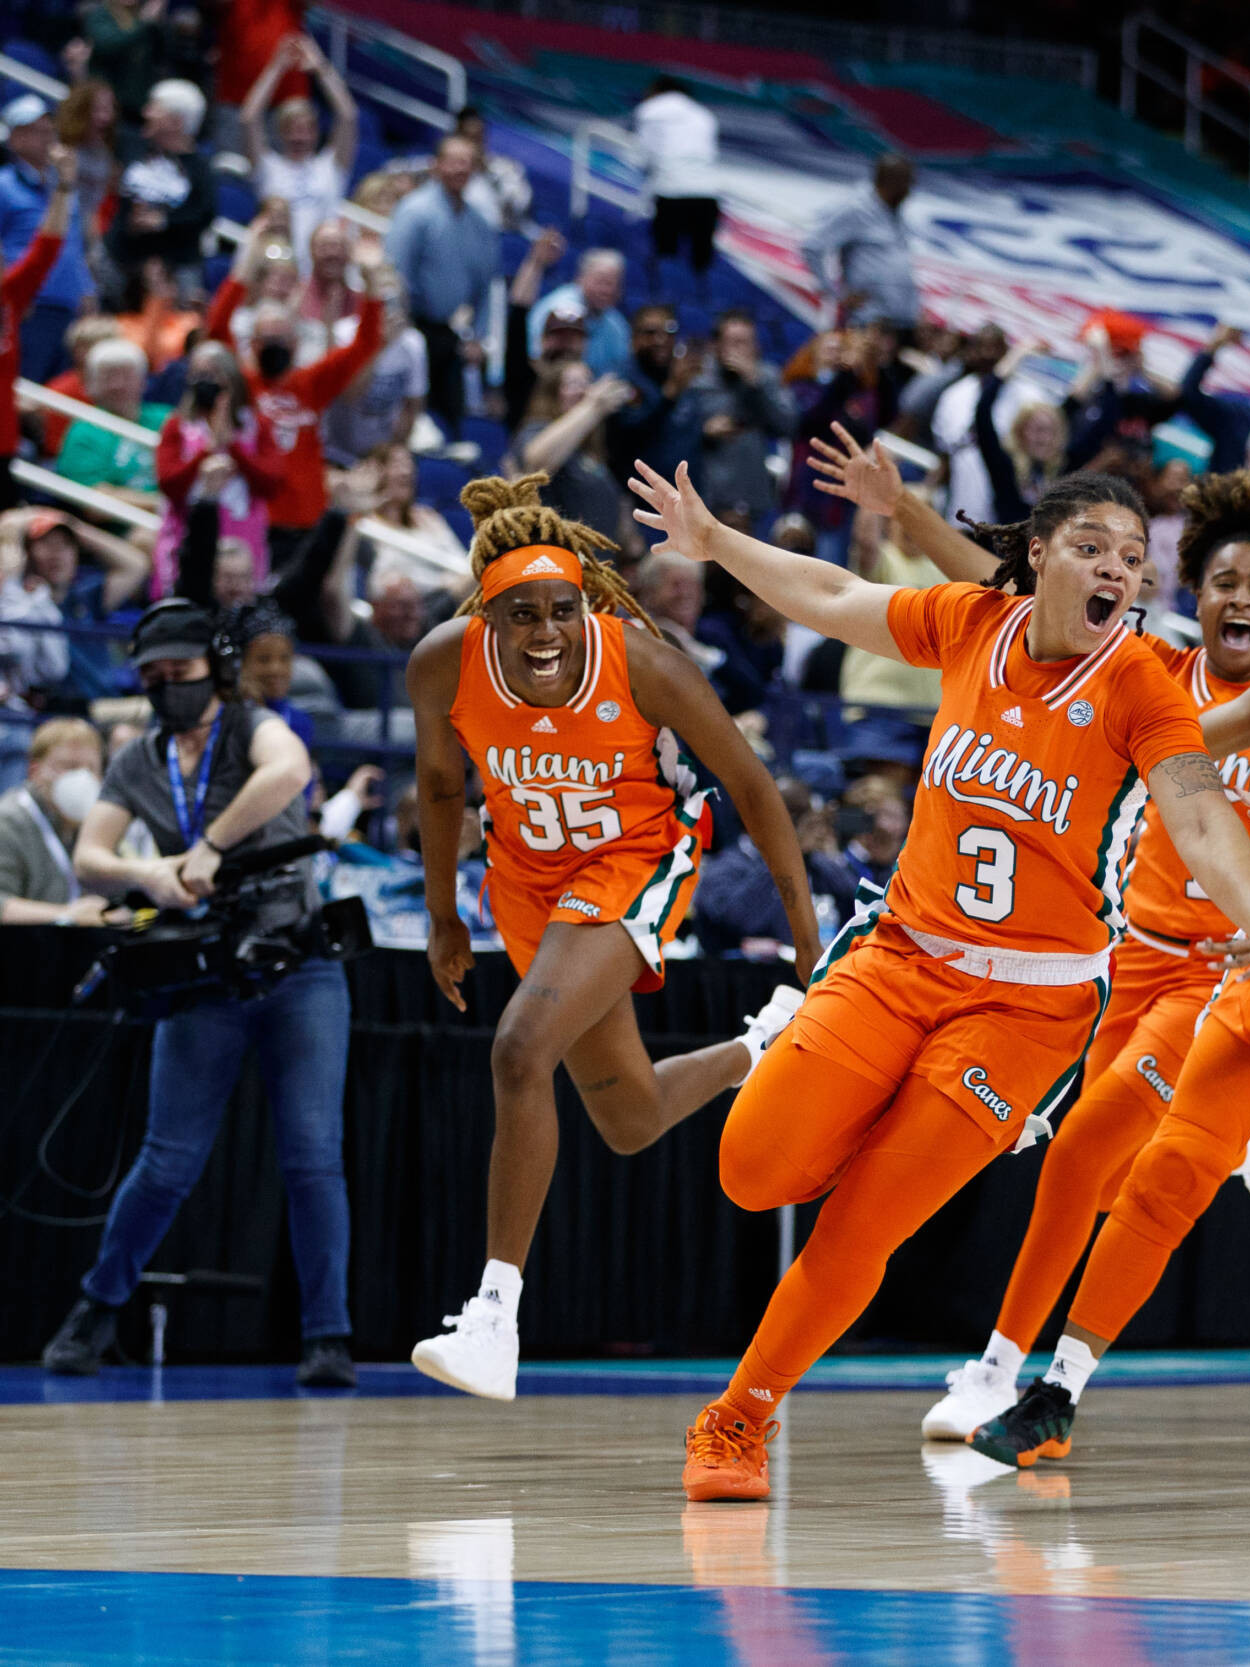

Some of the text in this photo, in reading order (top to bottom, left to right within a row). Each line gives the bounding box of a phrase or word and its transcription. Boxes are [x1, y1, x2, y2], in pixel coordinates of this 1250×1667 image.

[486, 745, 625, 791] Miami
[923, 723, 1079, 835] Miami
[510, 788, 623, 853] 35
[954, 825, 1017, 924] 3
[557, 890, 601, 918] Canes
[962, 1066, 1012, 1121] Canes
[1136, 1054, 1175, 1103] Canes
